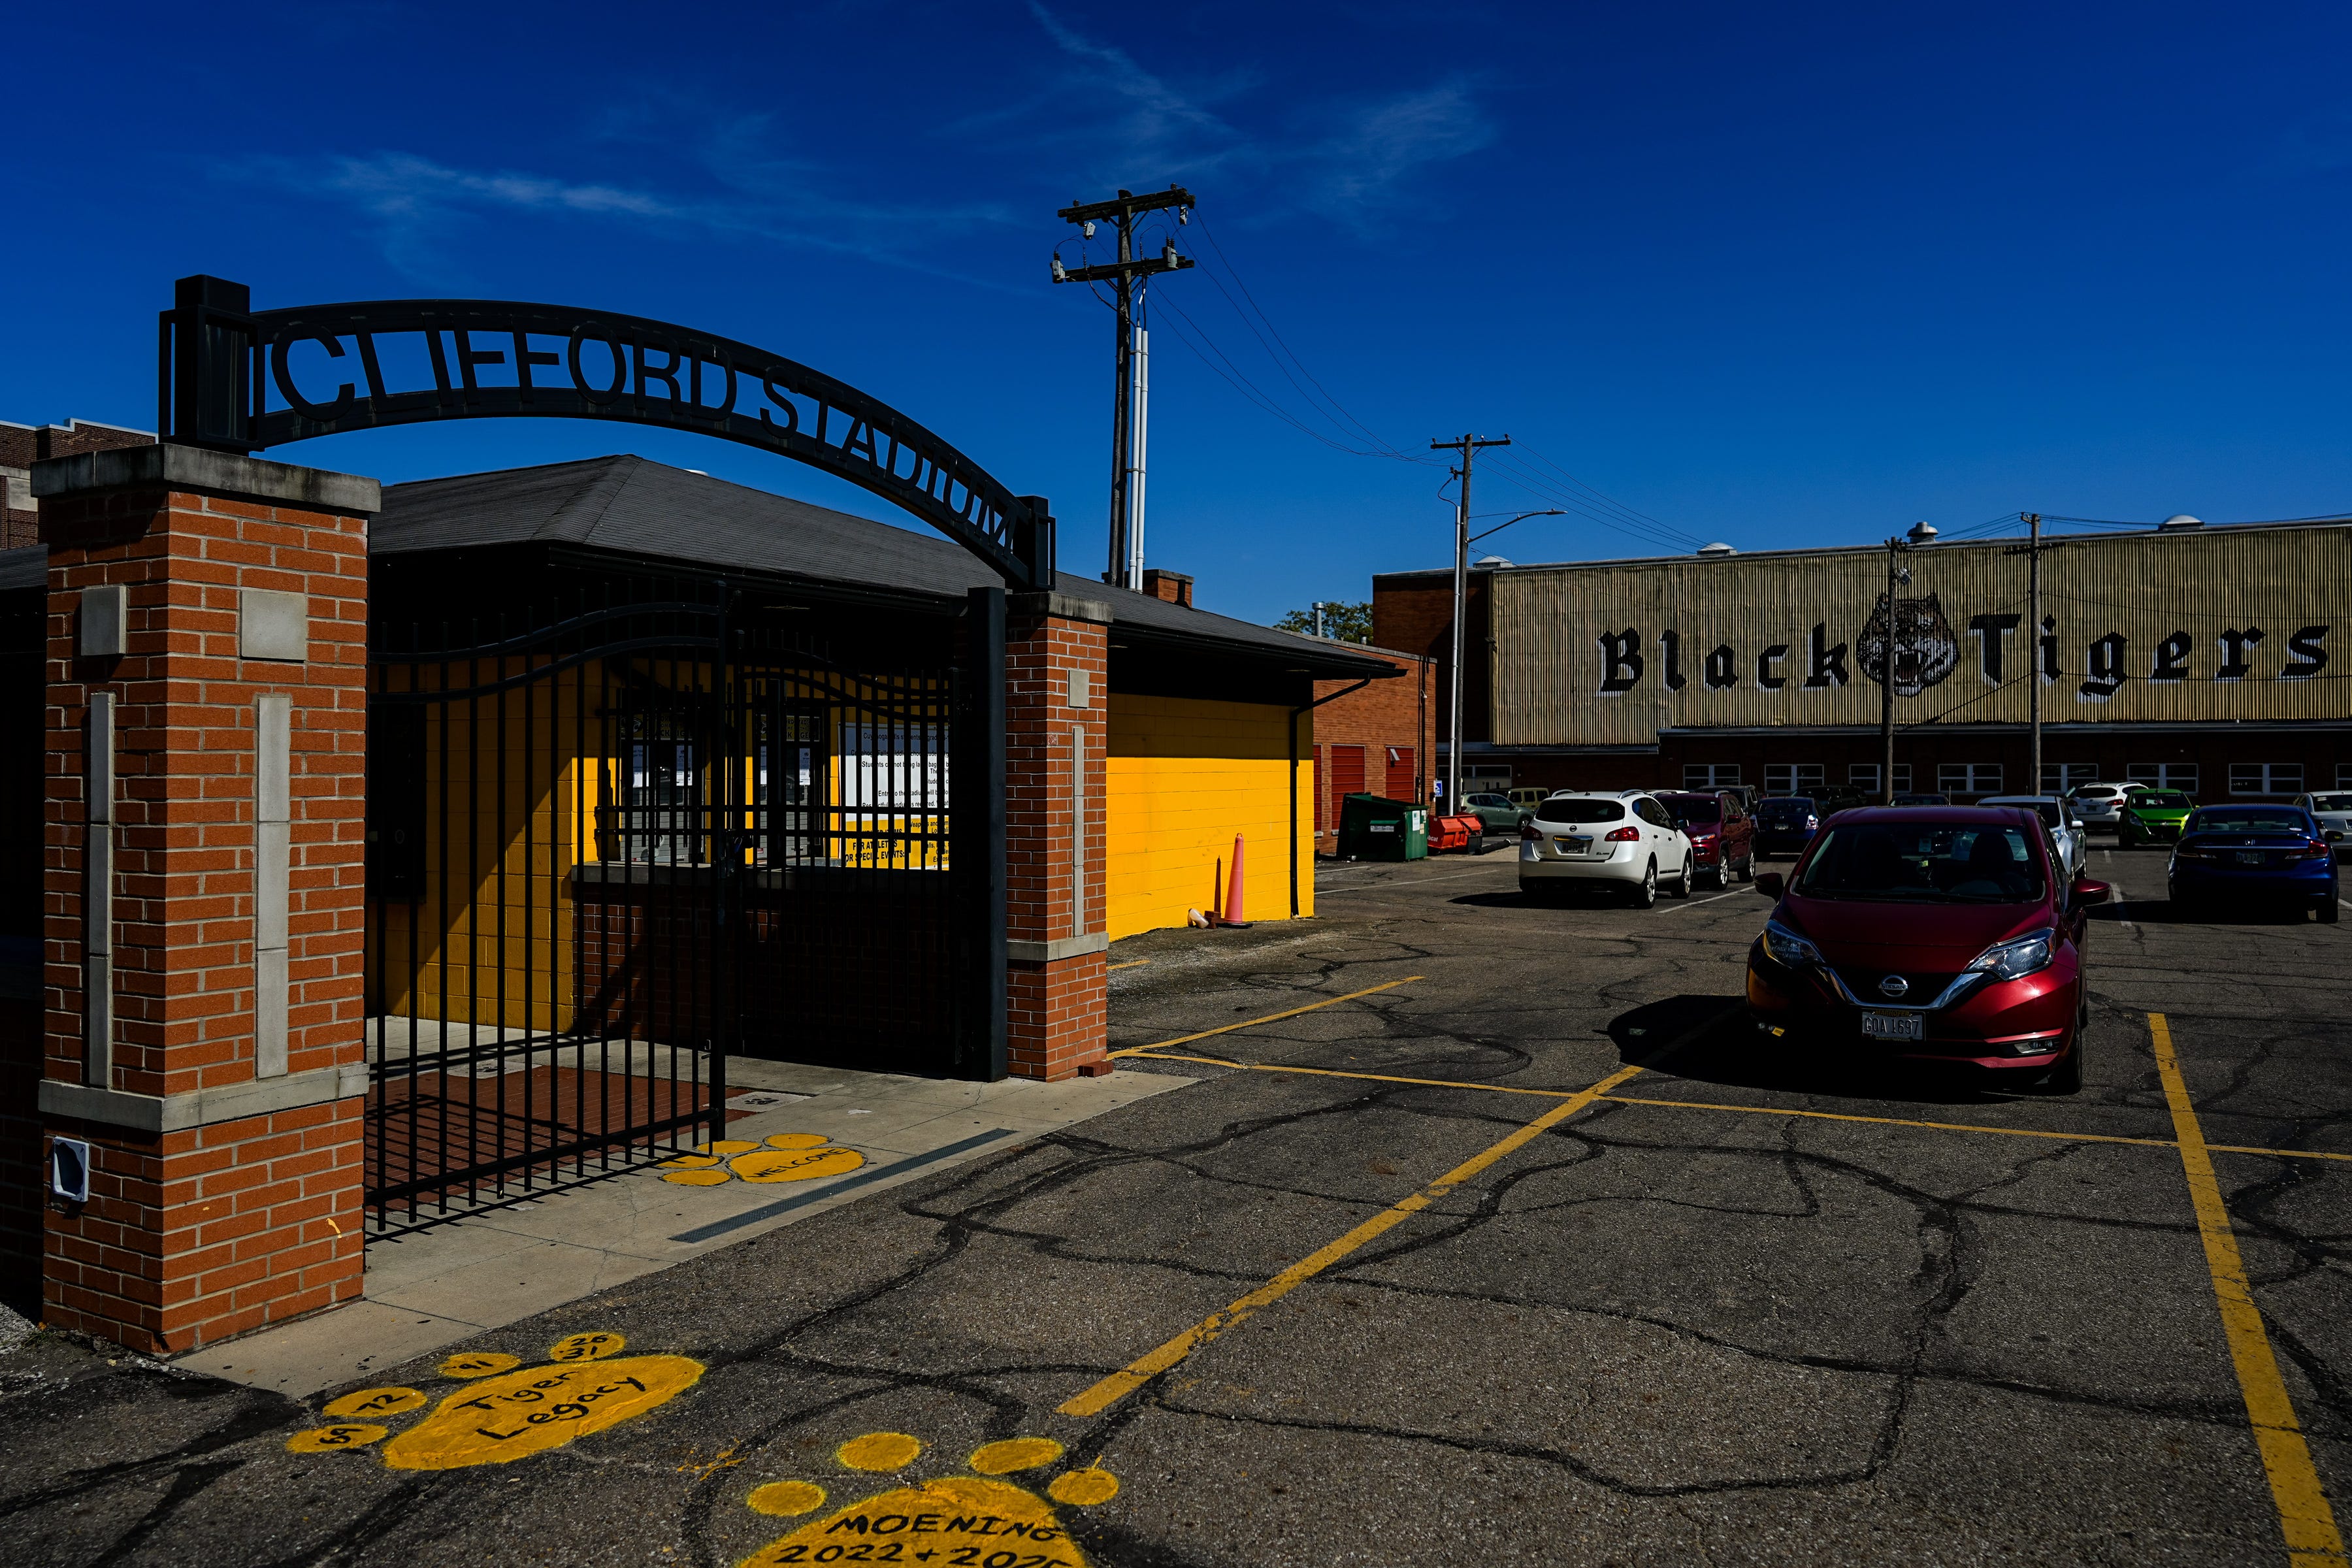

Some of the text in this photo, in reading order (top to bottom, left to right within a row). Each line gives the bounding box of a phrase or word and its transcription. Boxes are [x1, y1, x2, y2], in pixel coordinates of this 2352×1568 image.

[270, 312, 1029, 559] CLIFFORD STADIUM
[1596, 613, 2330, 702] Black Tigers
[863, 732, 888, 741] Cuyoga
[866, 840, 898, 849] ATLETS
[881, 850, 904, 859] EVNTS:
[1891, 1019, 1919, 1035] 1697
[746, 1149, 849, 1177] WELCOME
[452, 1371, 580, 1410] Tiger
[476, 1377, 645, 1440] Legacy
[825, 1514, 1061, 1541] MOENING
[773, 1543, 904, 1563] 2022
